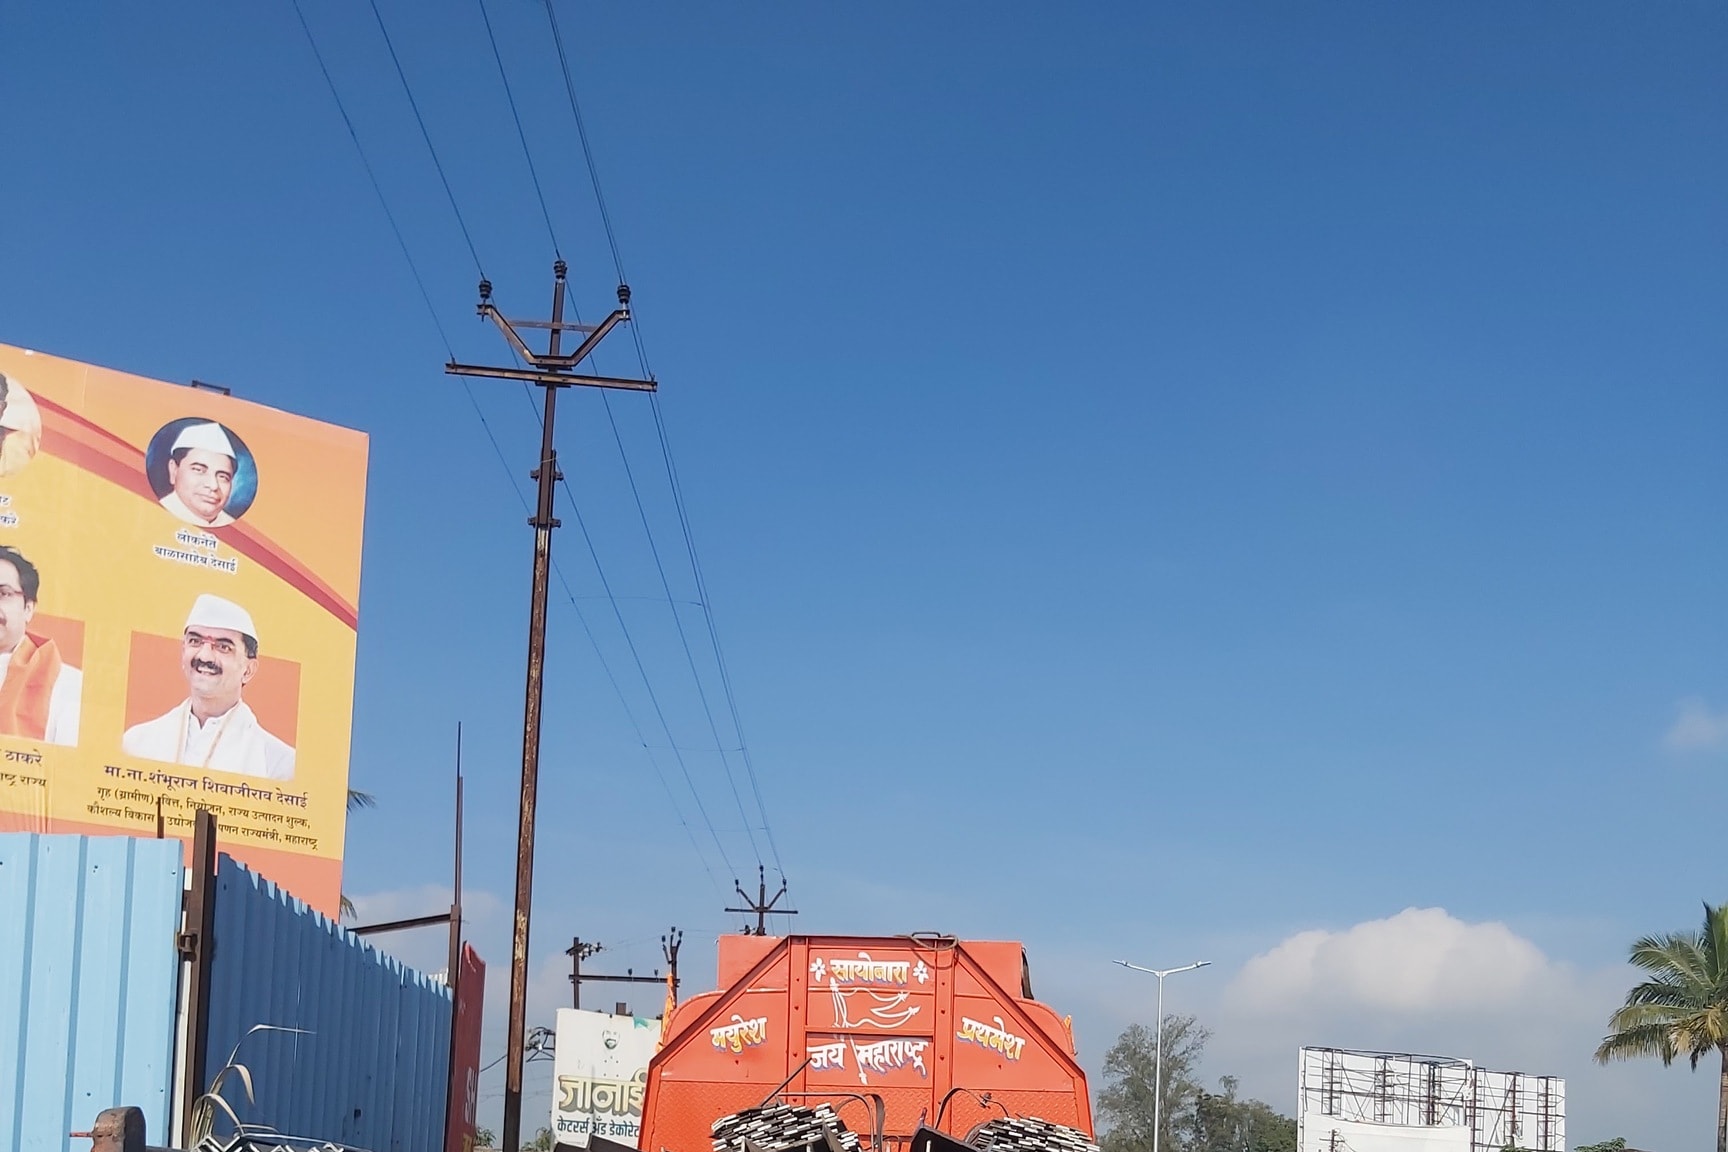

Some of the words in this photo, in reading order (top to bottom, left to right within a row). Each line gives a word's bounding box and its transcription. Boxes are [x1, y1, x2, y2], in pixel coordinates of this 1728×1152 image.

[177, 530, 217, 548] लोकनेते
[155, 546, 208, 565] बाळासाहेब
[210, 554, 236, 571] देसाई
[97, 786, 111, 801] गृह
[228, 806, 249, 818] राज्य
[251, 810, 283, 824] उत्पादन
[202, 776, 273, 802] शिवाजीराव
[275, 787, 308, 809] देसाई
[87, 801, 122, 818] कौशल्य
[124, 806, 155, 823] विकास
[285, 833, 318, 850] महाराष्ट्र
[830, 952, 911, 983] सायोनारा
[955, 1015, 1026, 1061] प्रथमेश
[854, 1038, 929, 1077] महाराष्ट्र
[557, 1115, 590, 1134] केटरर्स
